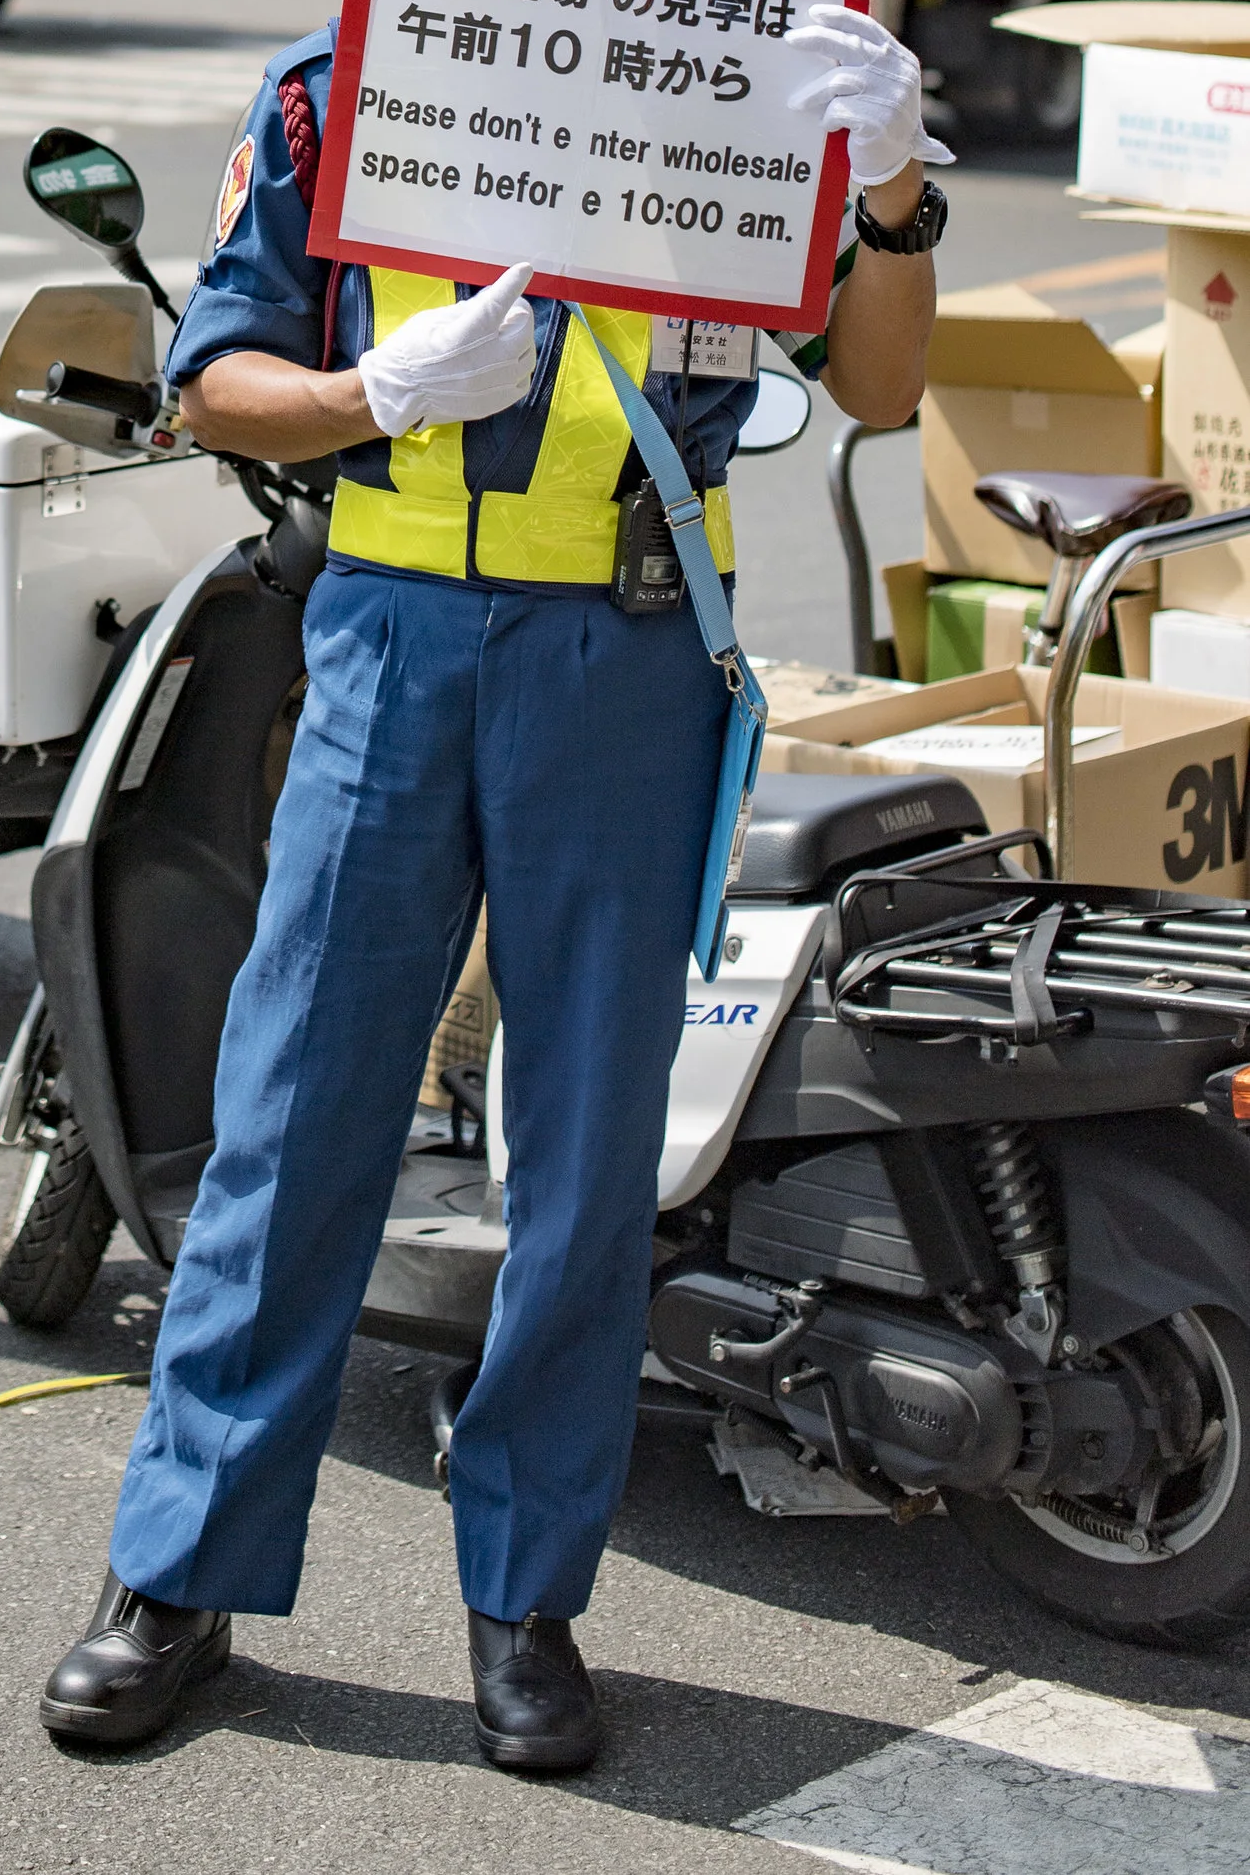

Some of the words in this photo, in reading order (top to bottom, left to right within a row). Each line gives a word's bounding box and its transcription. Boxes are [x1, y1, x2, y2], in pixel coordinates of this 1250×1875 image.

[397, 2, 582, 75] 午前10
[602, 38, 751, 102] 時から
[357, 86, 456, 130] Please
[468, 106, 542, 146] don't
[662, 141, 811, 184] wholesale
[361, 151, 461, 191] space
[620, 189, 724, 234] 10:00
[736, 212, 793, 243] am.
[875, 799, 935, 835] YAMAHA
[1163, 754, 1249, 885] 3M
[891, 1396, 949, 1436] YAMAHA
